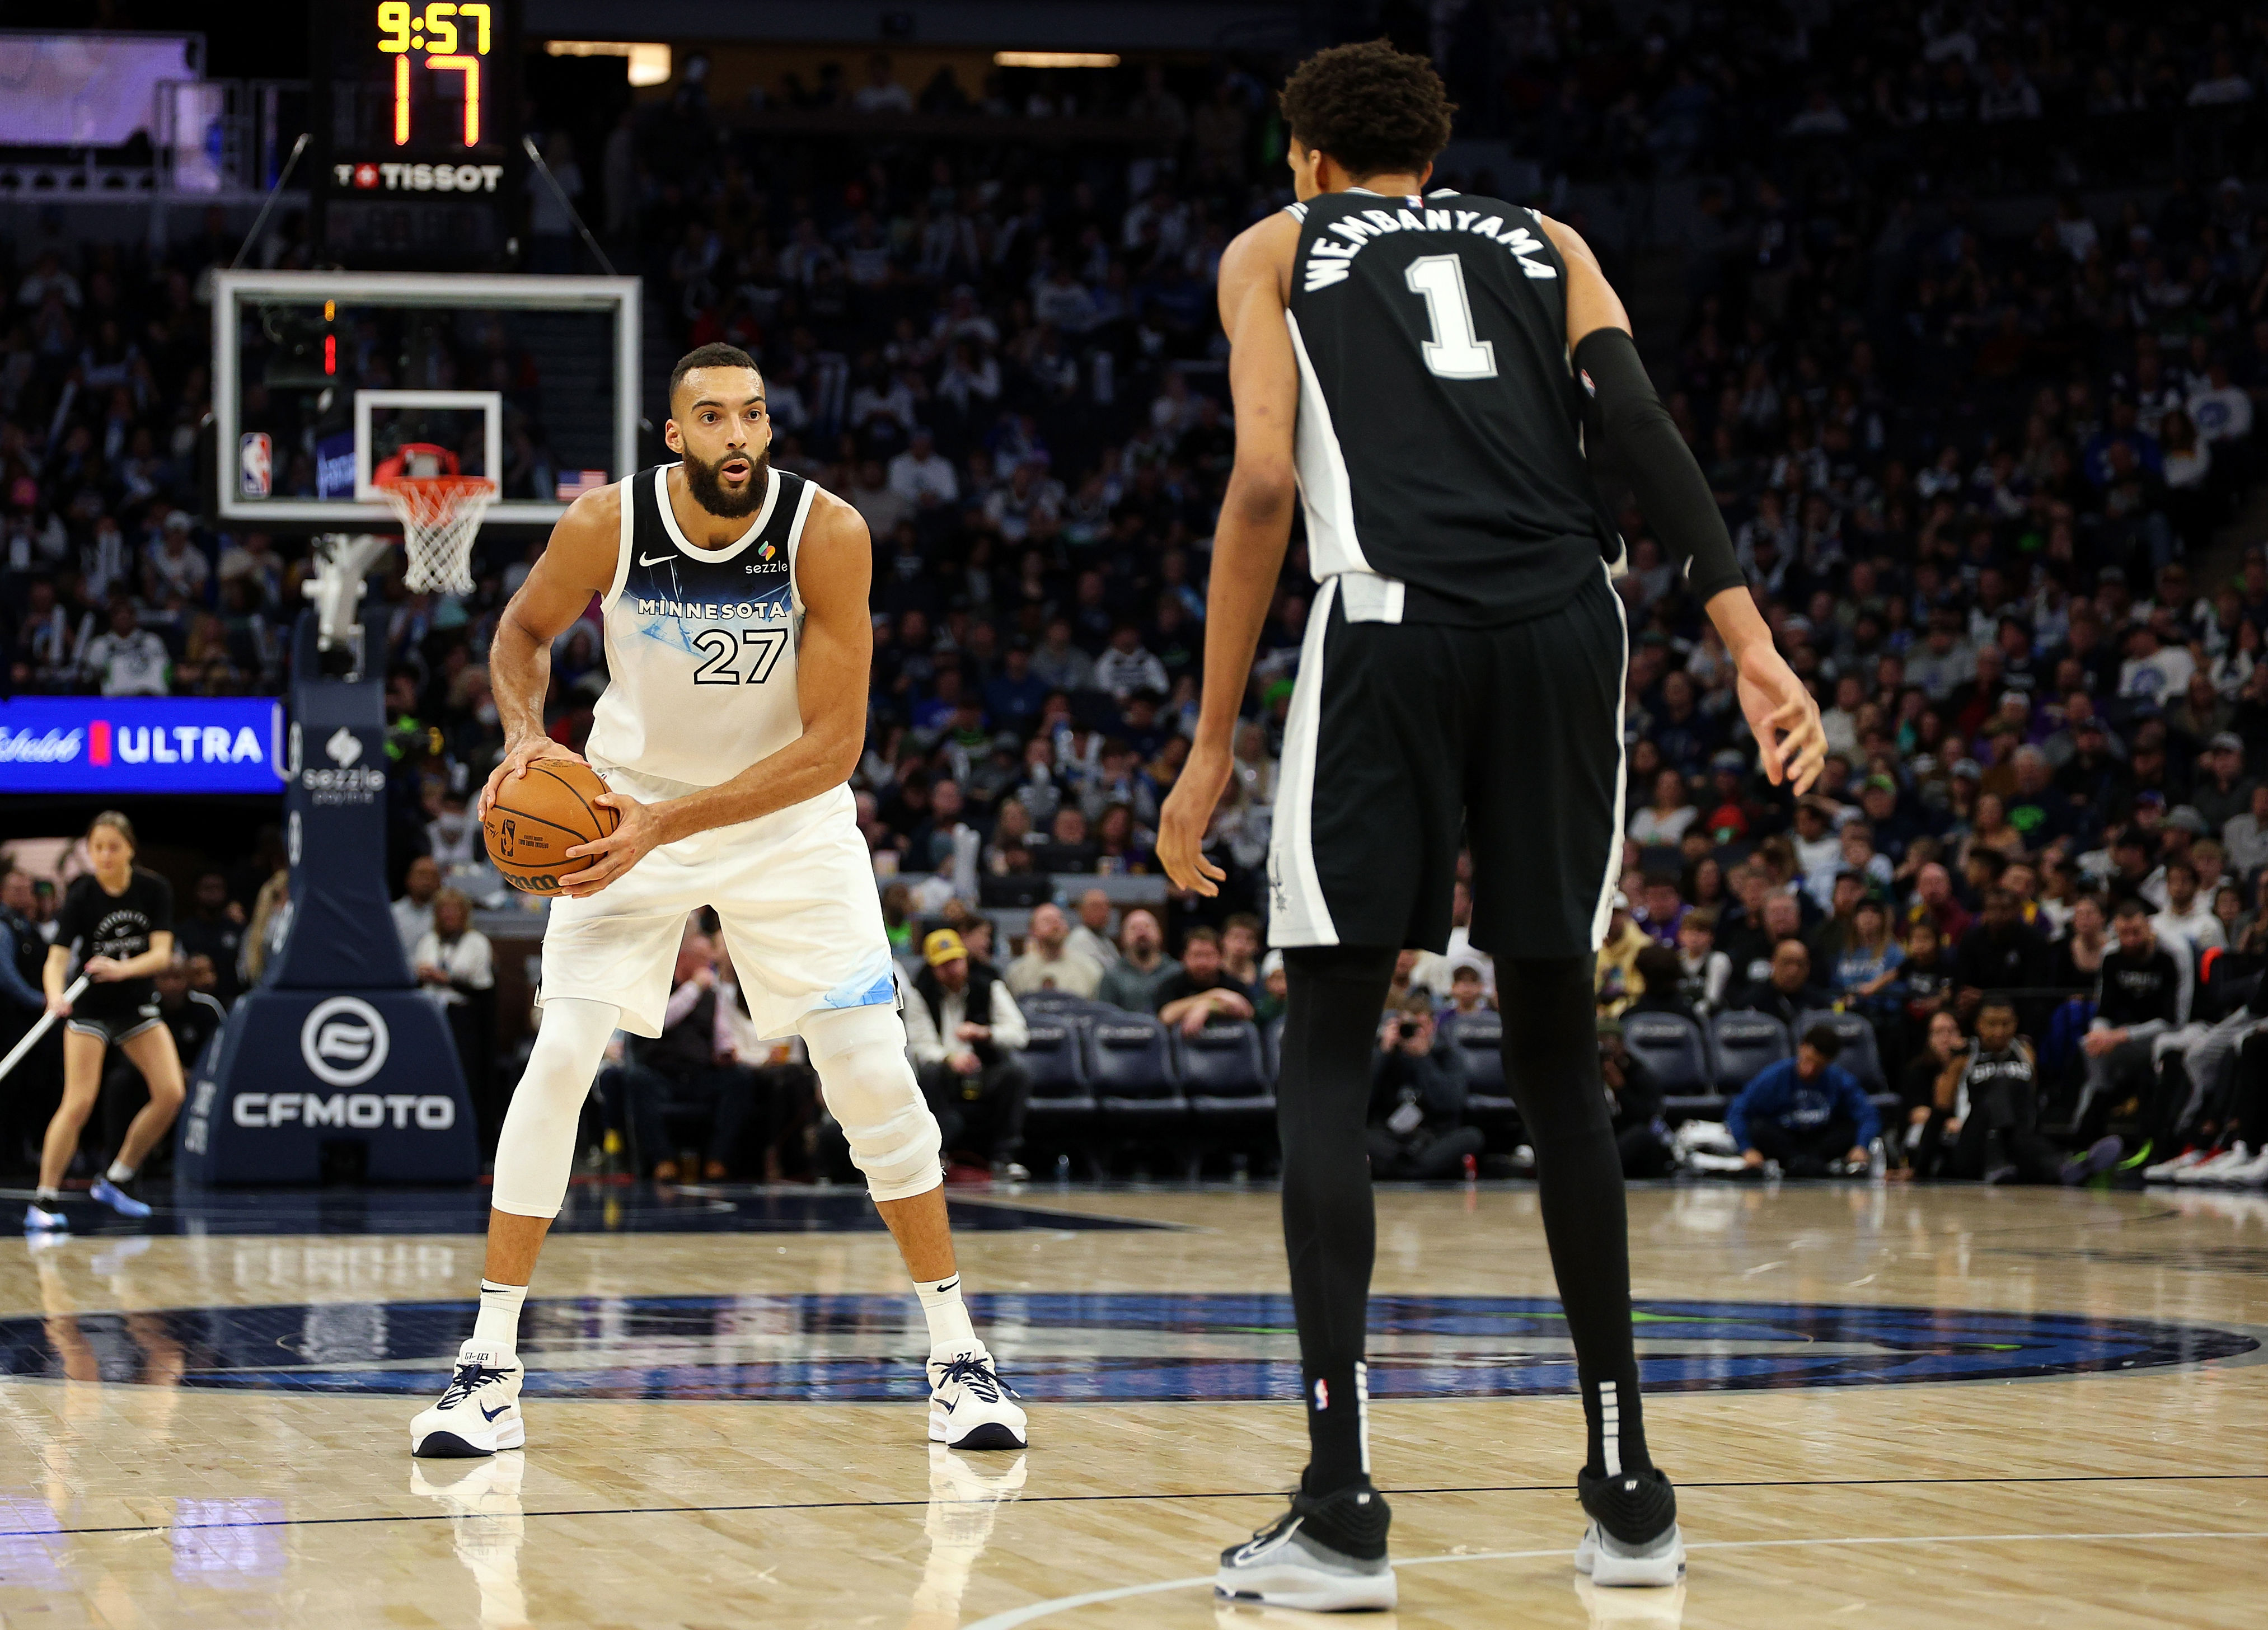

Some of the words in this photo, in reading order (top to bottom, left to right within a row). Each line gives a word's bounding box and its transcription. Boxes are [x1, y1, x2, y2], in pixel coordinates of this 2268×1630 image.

[378, 1, 491, 54] 9:57
[395, 54, 479, 147] 17
[381, 163, 503, 192] TISSOT
[1304, 209, 1557, 292] WEMBANYAMA
[1404, 253, 1498, 380] 1
[745, 560, 788, 574] sezzle
[638, 598, 787, 620] MINNESOTA
[692, 627, 788, 685] 27
[118, 726, 263, 764] ULTRA
[233, 1093, 456, 1130] CFMOTO
